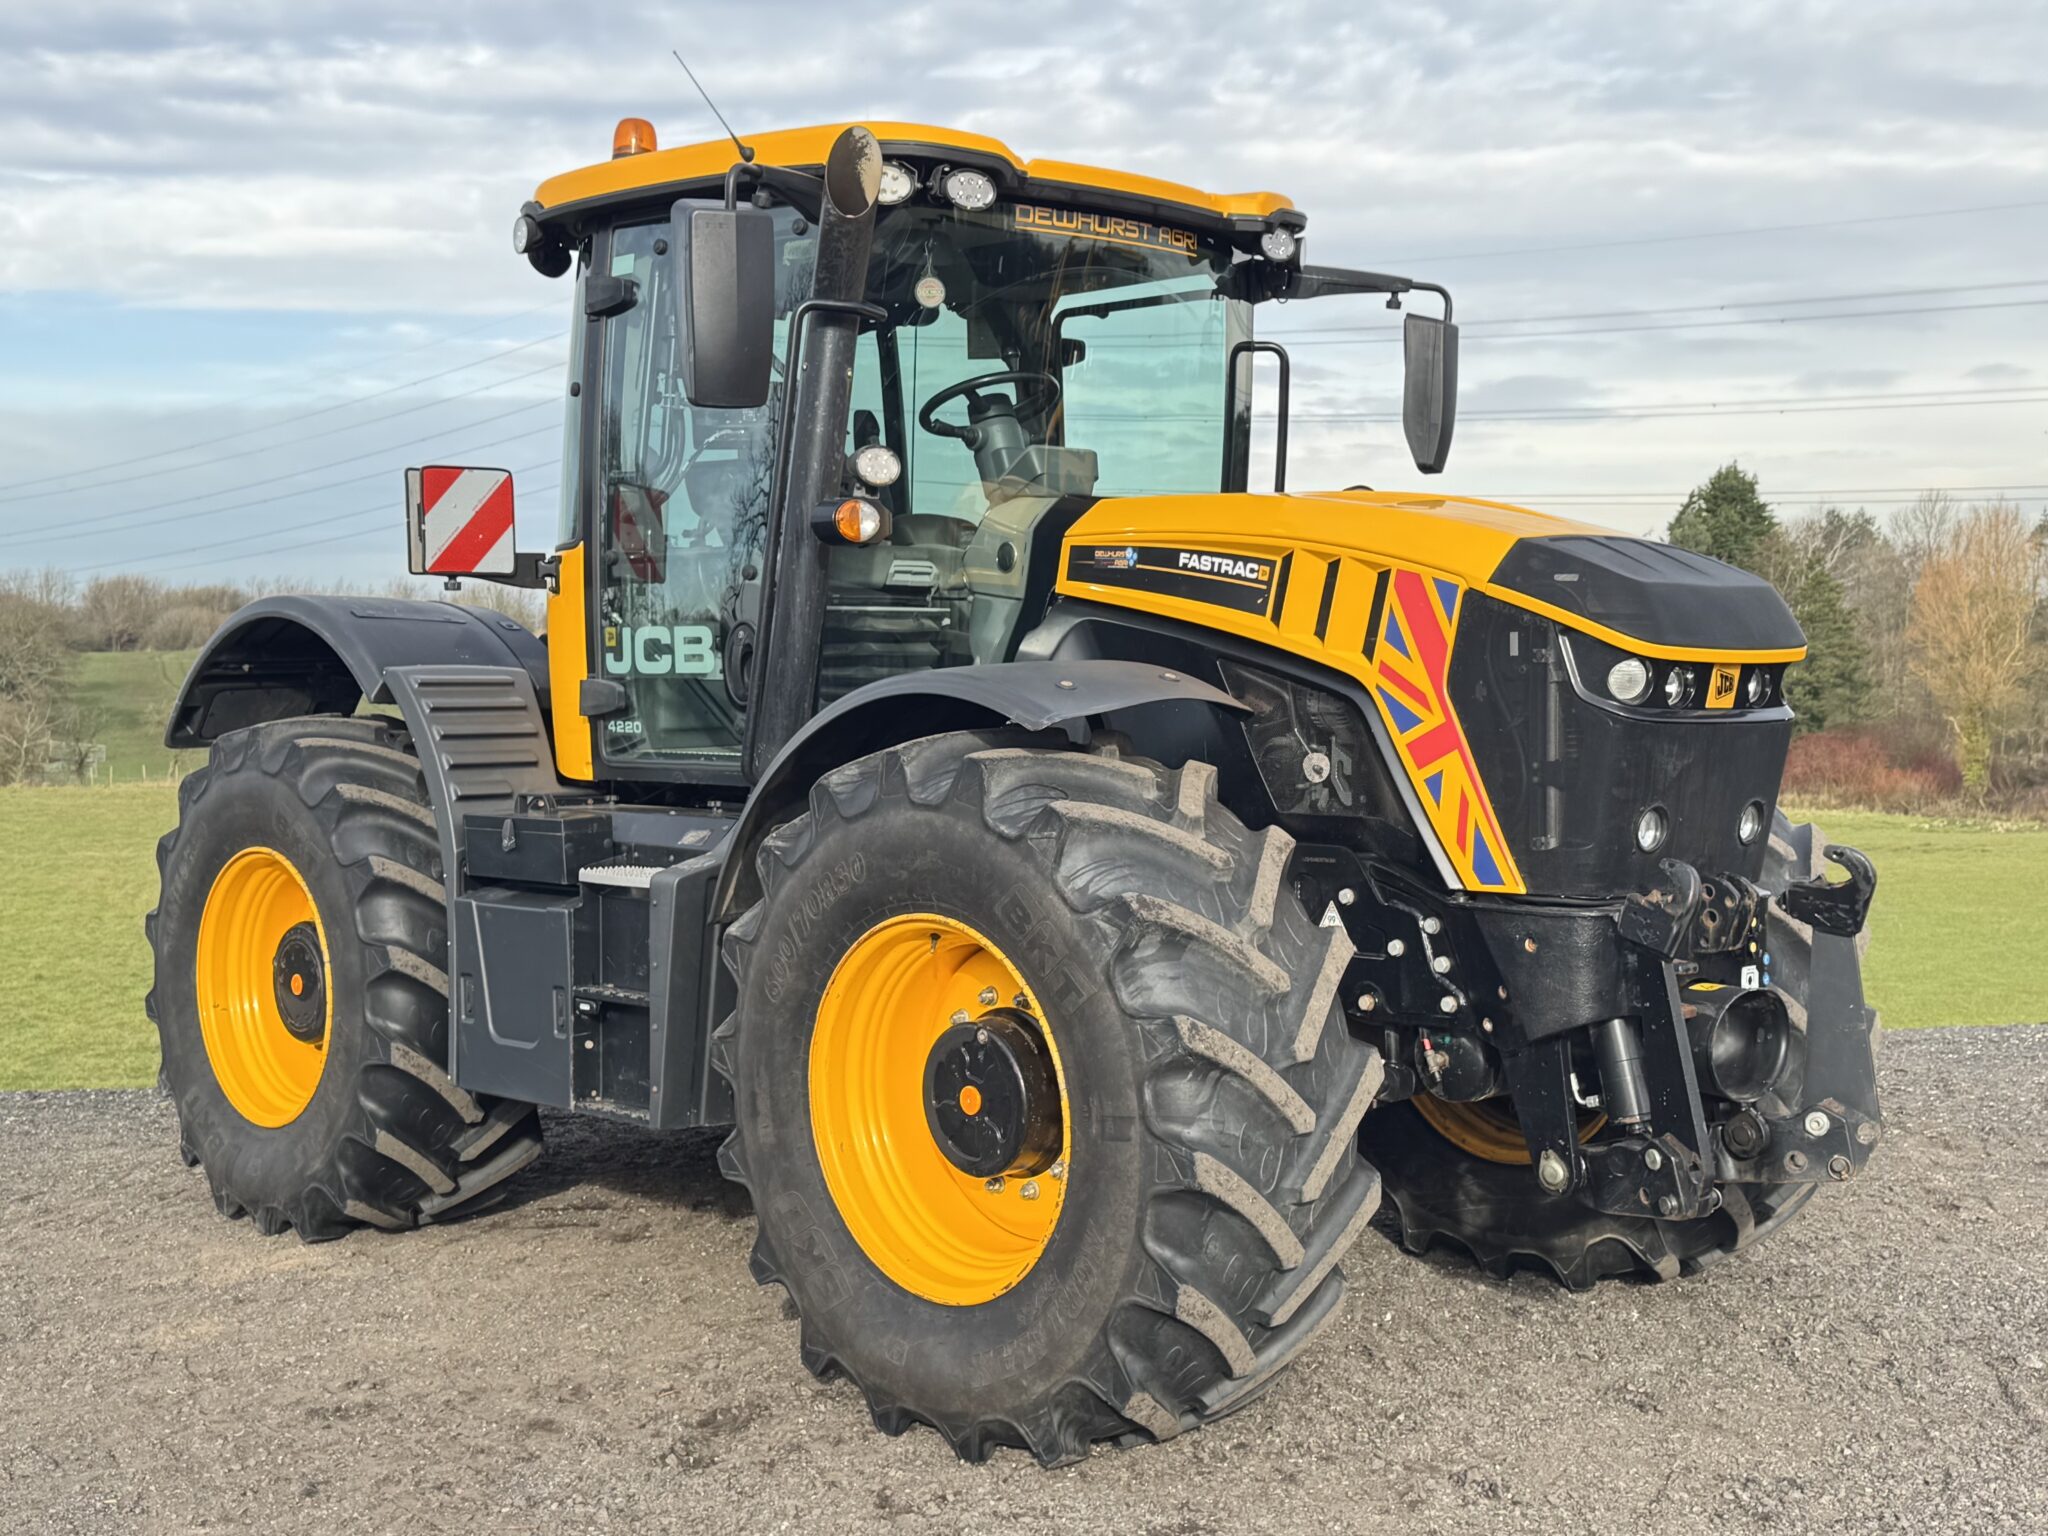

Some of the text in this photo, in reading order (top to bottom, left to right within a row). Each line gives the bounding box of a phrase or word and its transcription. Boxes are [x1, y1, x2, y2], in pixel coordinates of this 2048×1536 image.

[1015, 204, 1198, 250] DEWHURST AGRI
[1179, 552, 1258, 579] FASTRAC
[605, 625, 715, 674] JCB
[1717, 672, 1735, 697] JCB
[608, 720, 642, 733] 4220
[997, 886, 1095, 1013] BKT
